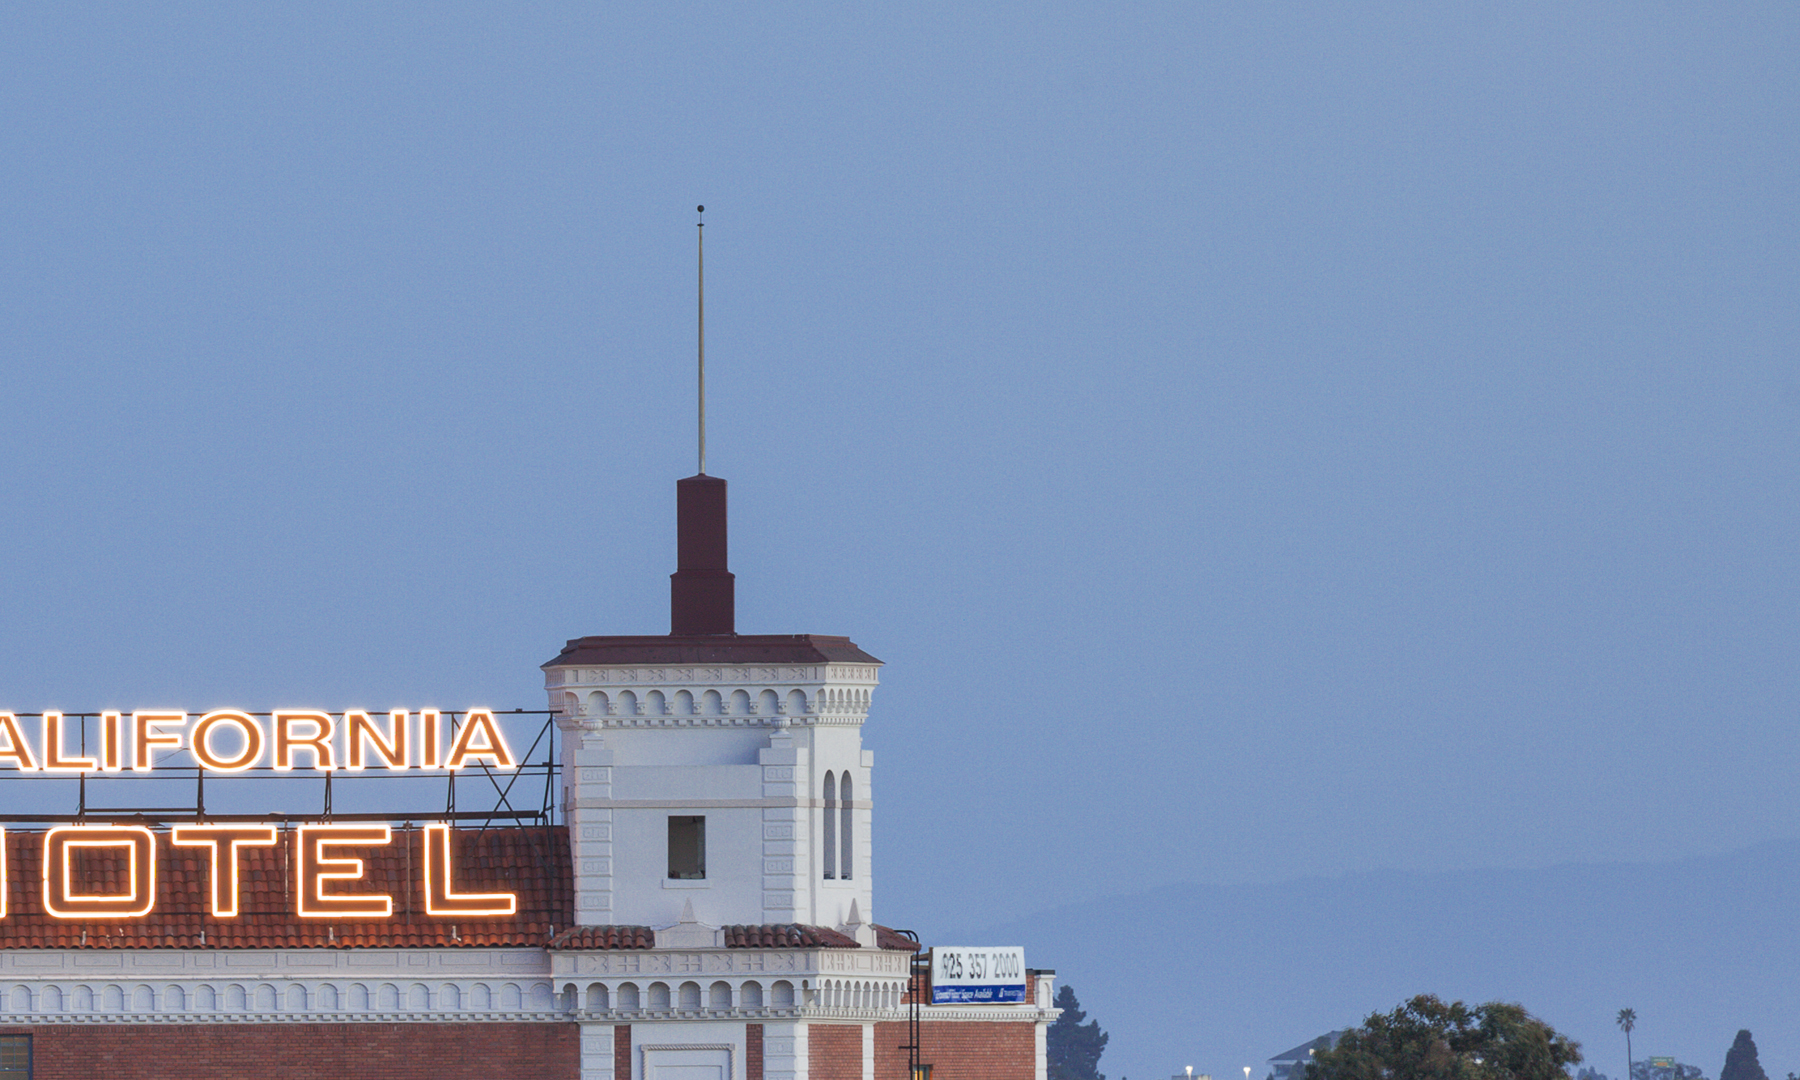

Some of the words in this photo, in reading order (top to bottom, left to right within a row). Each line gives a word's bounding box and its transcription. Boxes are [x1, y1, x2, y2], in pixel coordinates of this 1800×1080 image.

[941, 952, 963, 979] 925
[968, 952, 987, 979] 357
[992, 952, 1019, 979] 2000
